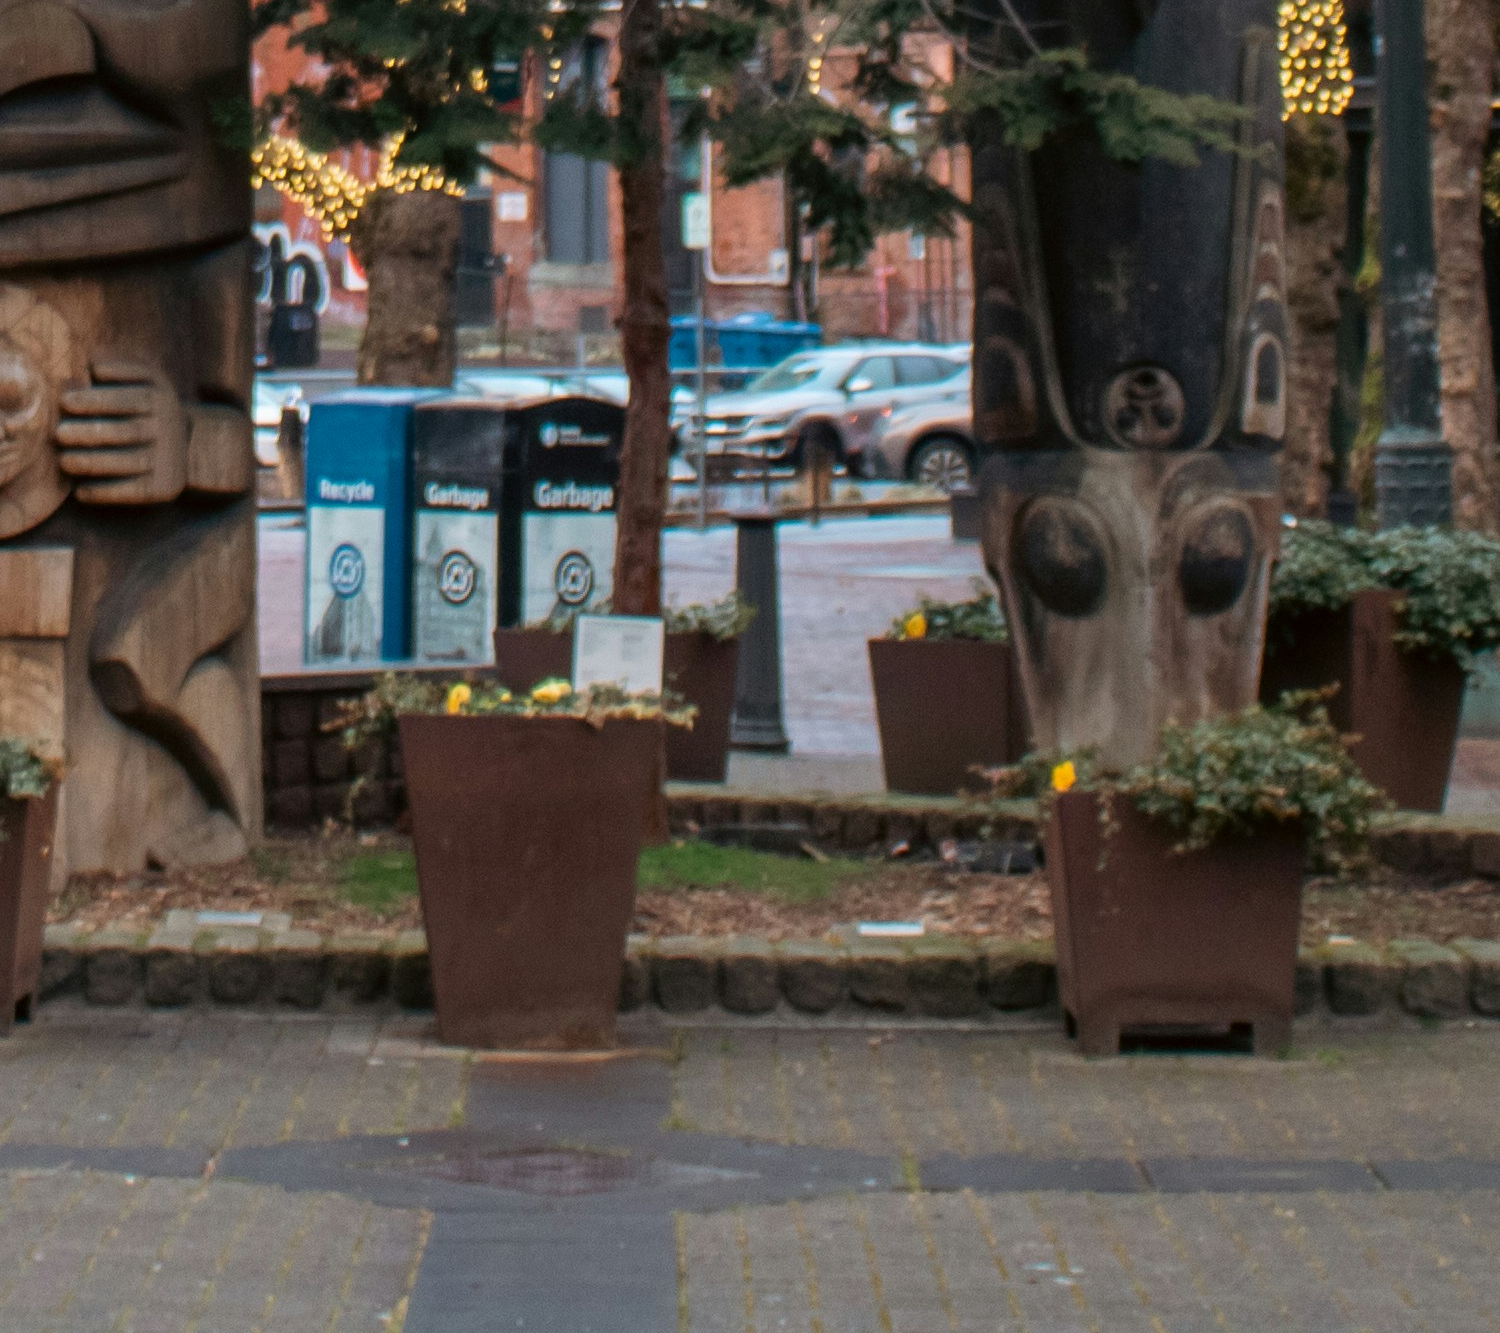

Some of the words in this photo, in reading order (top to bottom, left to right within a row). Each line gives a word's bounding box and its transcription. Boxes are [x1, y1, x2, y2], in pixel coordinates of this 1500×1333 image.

[320, 479, 375, 503] Recycle
[424, 483, 490, 510] Garbage
[535, 480, 614, 512] Garbage
